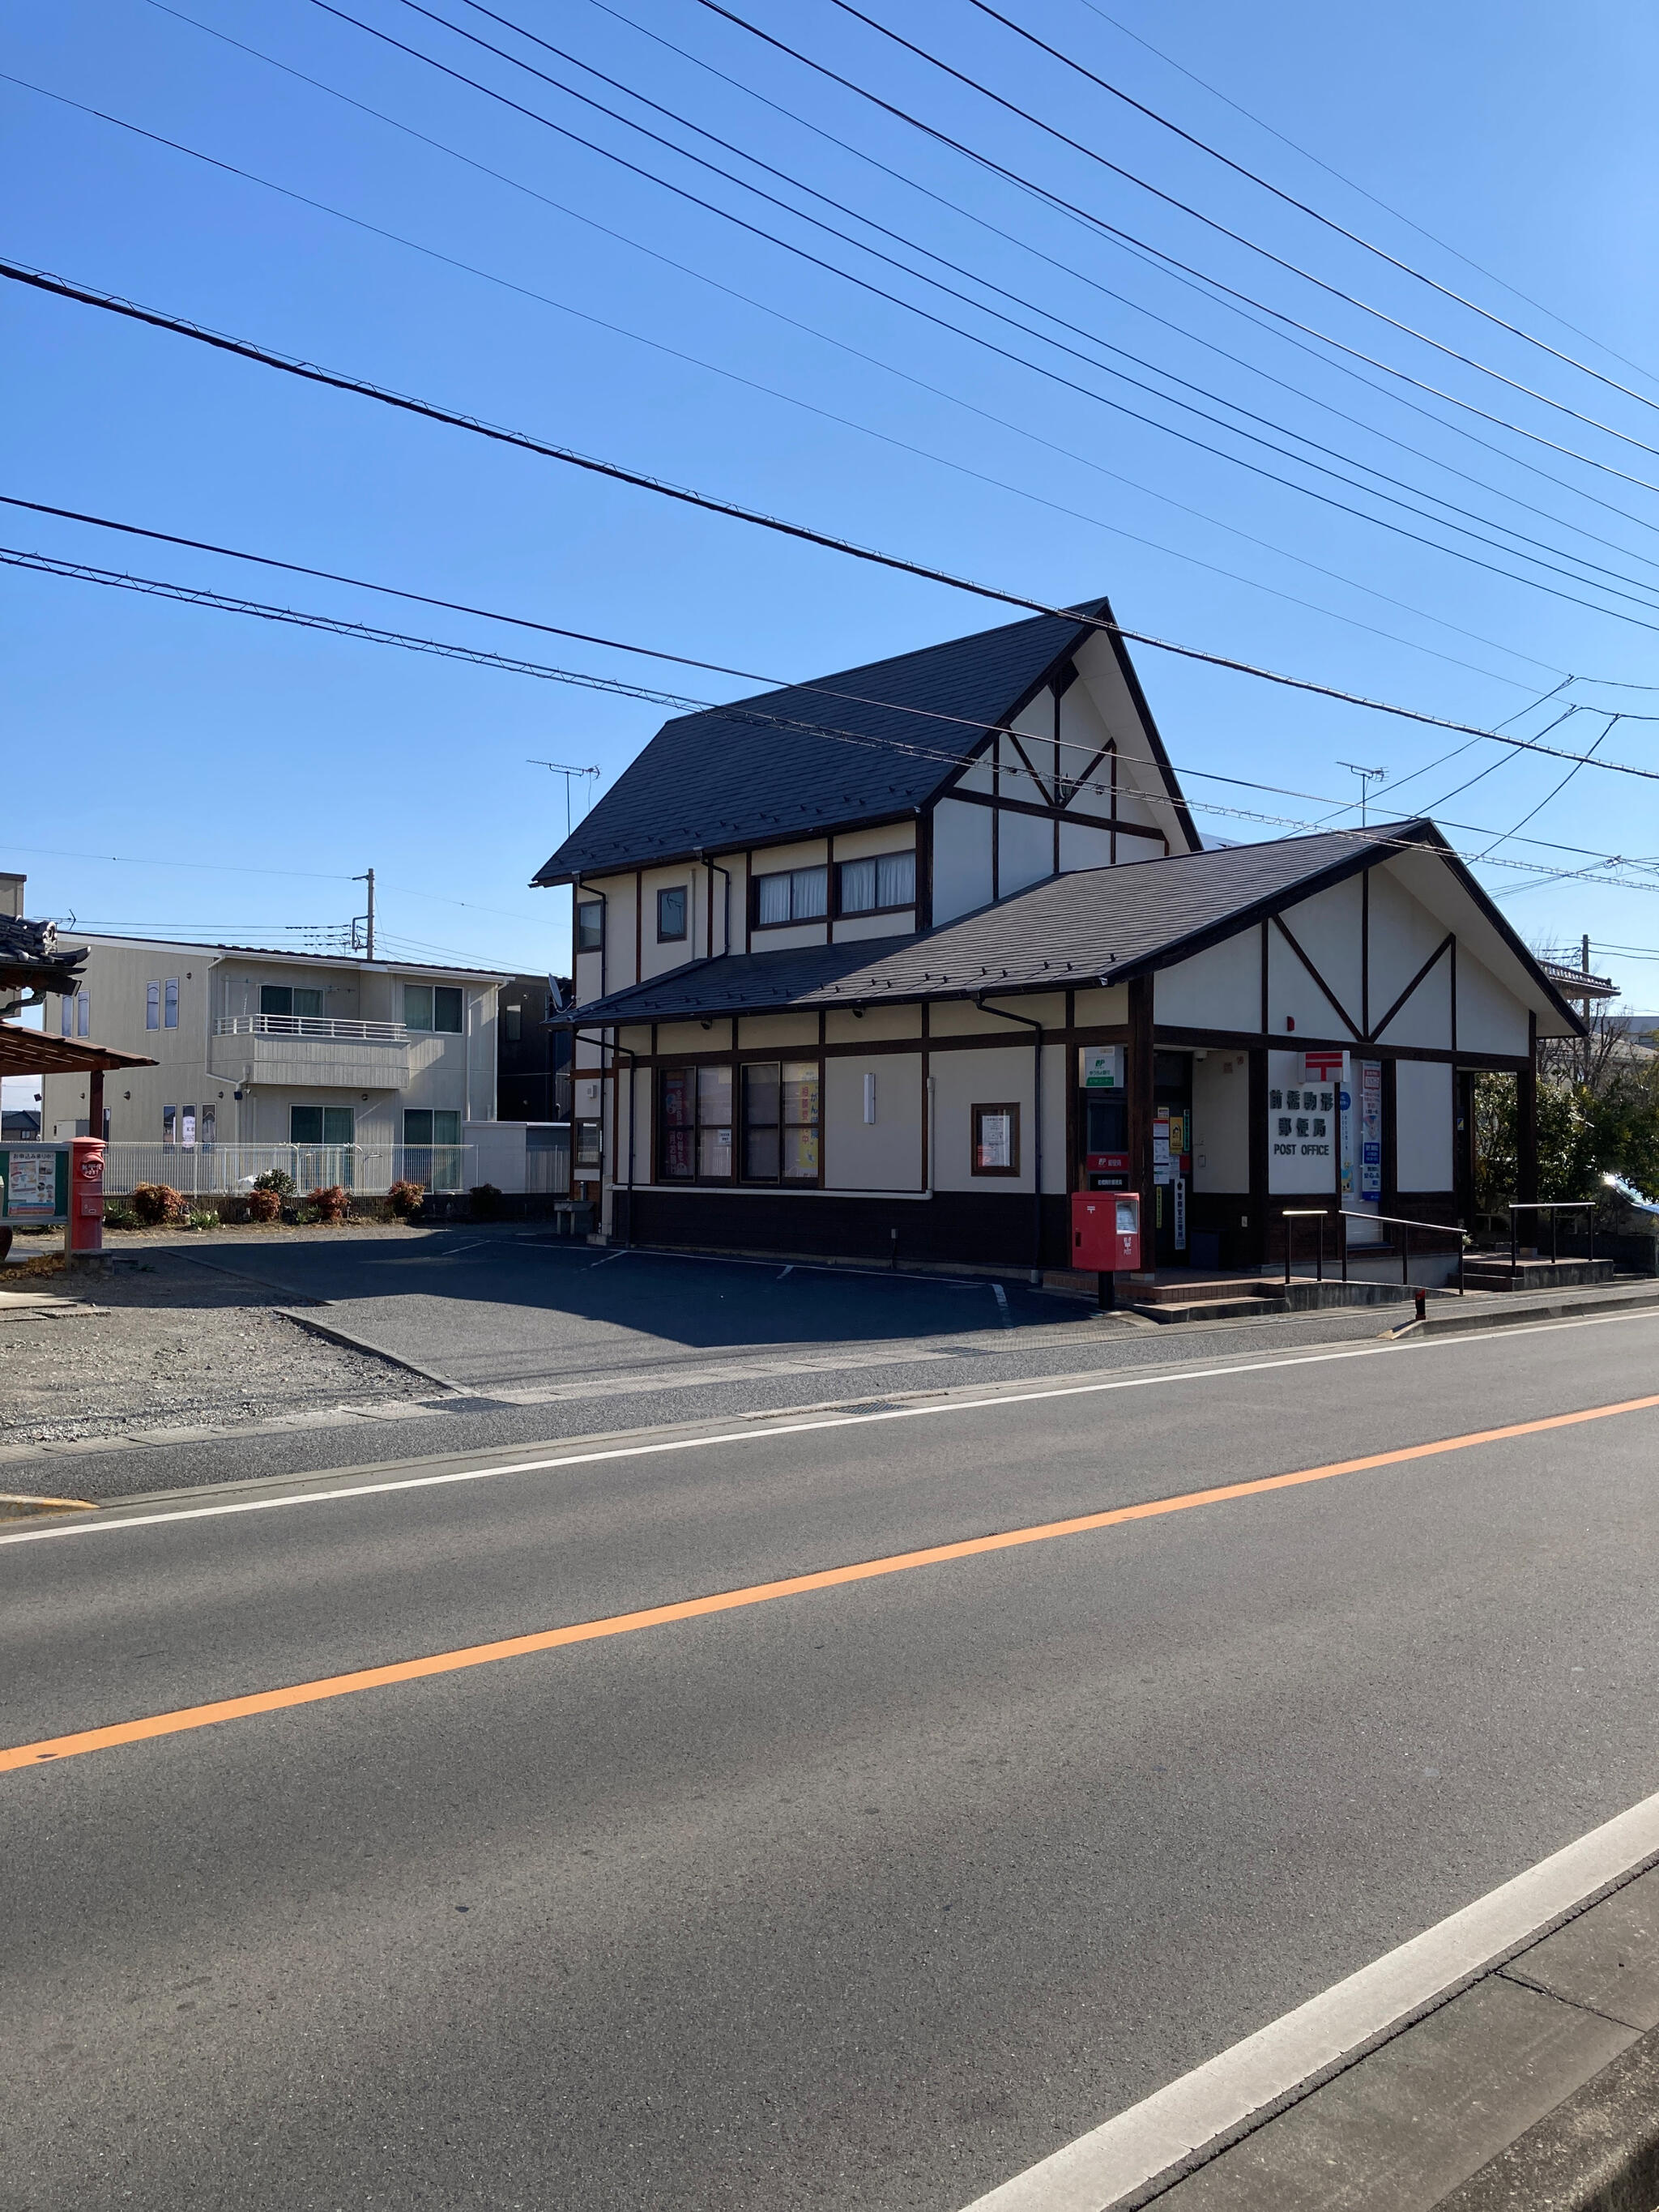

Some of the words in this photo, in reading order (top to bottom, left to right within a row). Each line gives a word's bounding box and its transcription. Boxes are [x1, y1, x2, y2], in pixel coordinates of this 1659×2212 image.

[1269, 1089, 1333, 1111] 前橋駒形
[1278, 1118, 1326, 1137] 郵便局
[1274, 1144, 1296, 1155] POST
[1301, 1144, 1329, 1155] OFFICE
